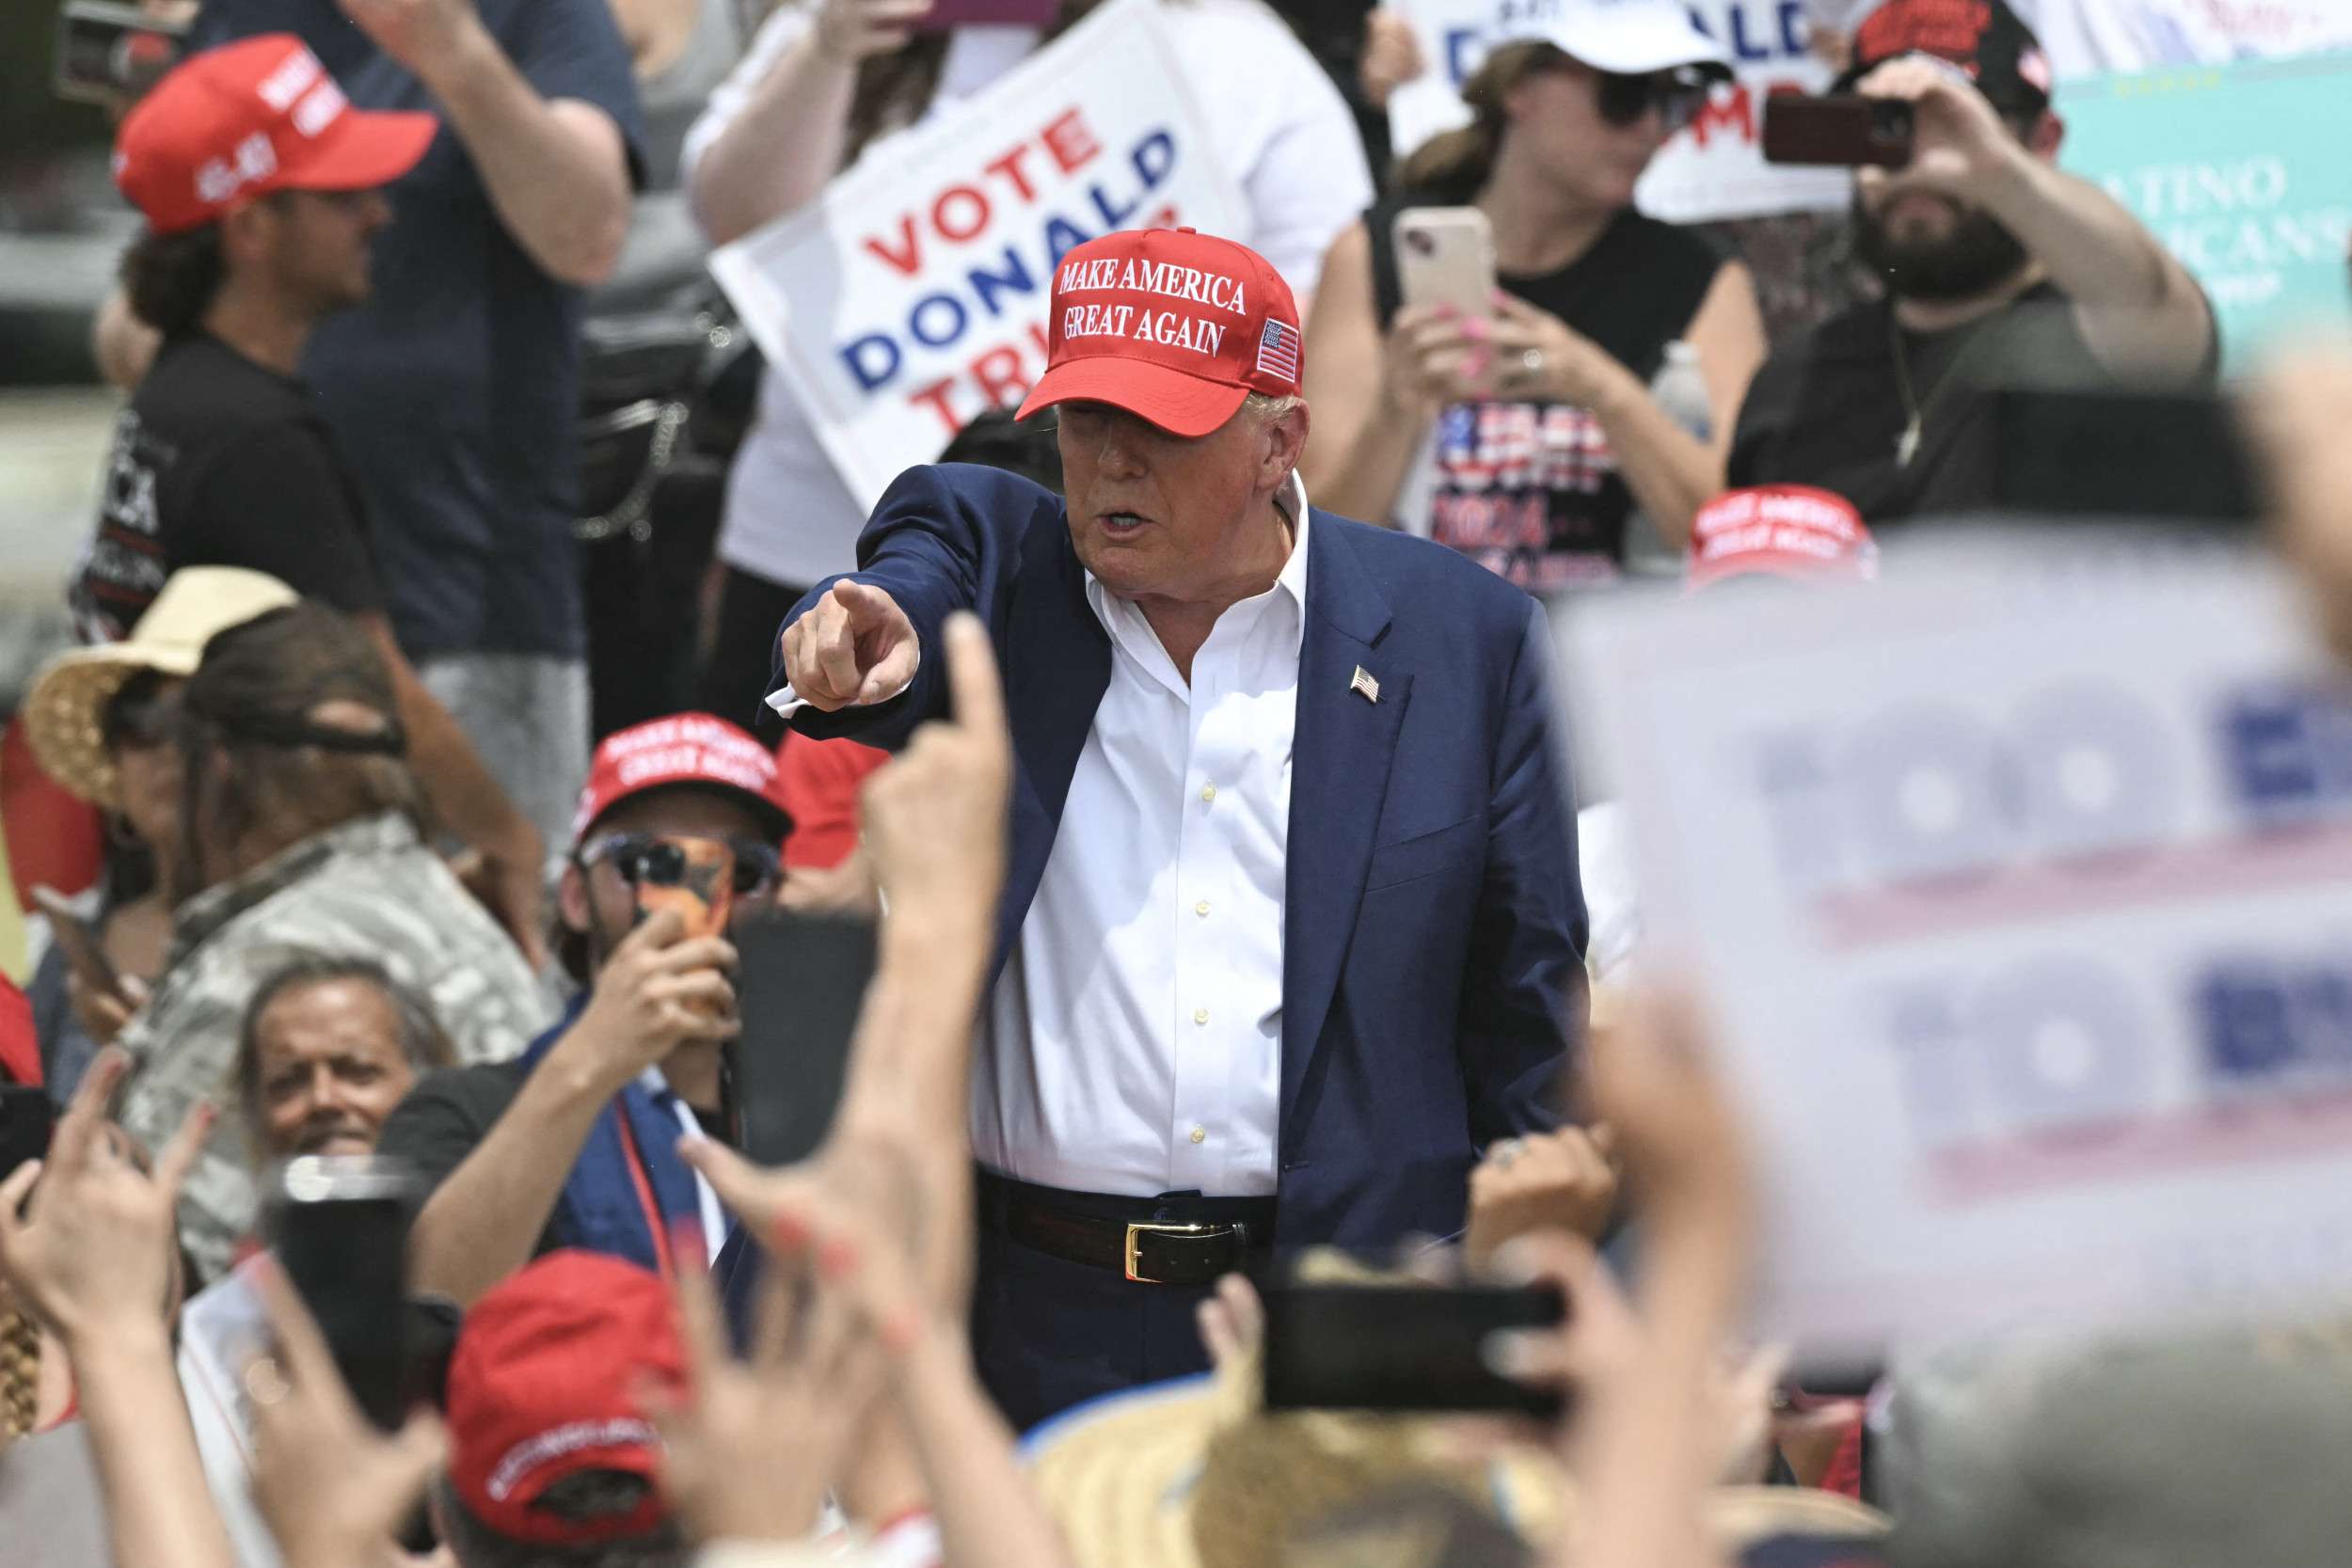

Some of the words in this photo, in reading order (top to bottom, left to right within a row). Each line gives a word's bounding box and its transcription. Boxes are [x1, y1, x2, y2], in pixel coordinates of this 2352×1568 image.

[862, 104, 1104, 279] VOTE
[838, 127, 1179, 393] DONALD
[1057, 258, 1119, 295] MAKE
[1118, 257, 1247, 316] AMERICA
[1063, 304, 1134, 341] GREAT
[1133, 309, 1227, 358] AGAIN
